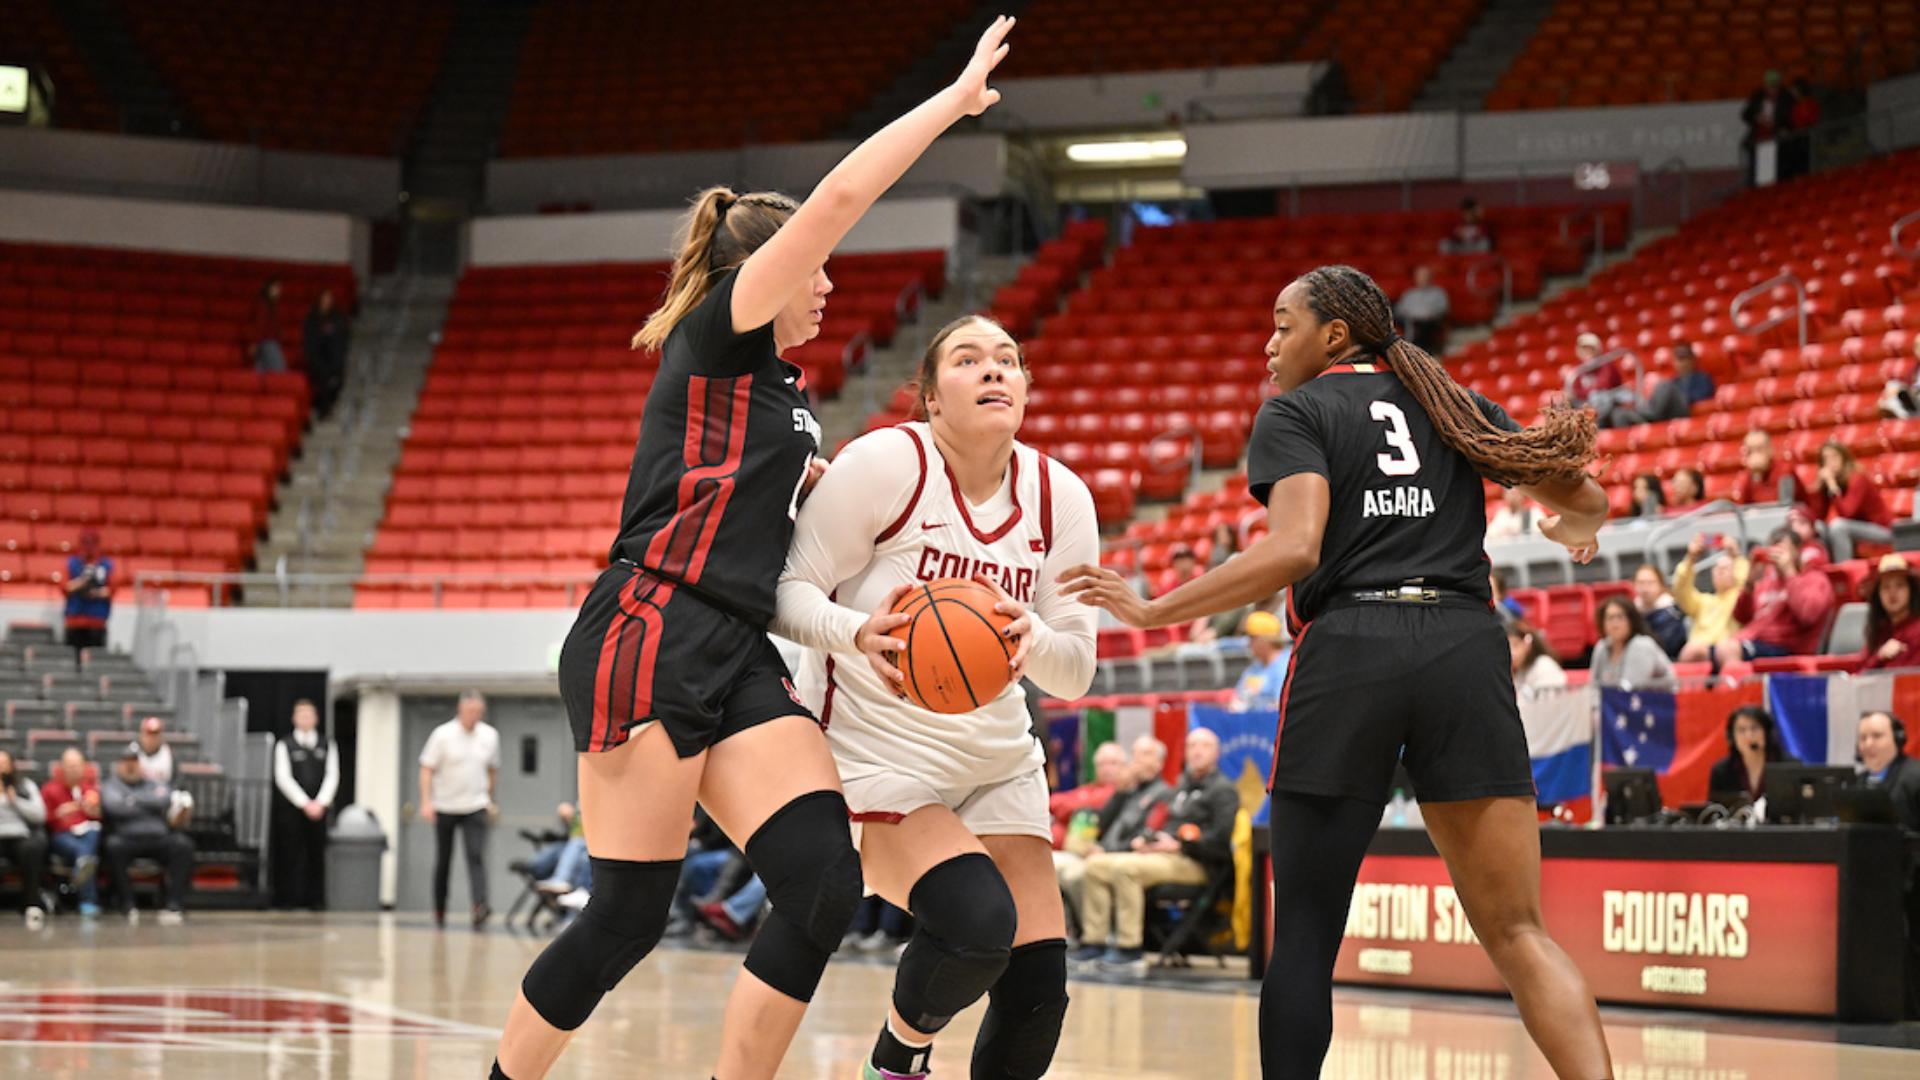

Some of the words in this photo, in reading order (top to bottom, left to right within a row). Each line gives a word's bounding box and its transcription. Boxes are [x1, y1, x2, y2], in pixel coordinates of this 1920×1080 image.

[1369, 401, 1420, 475] 3
[1363, 486, 1435, 518] AGARA
[1603, 890, 1748, 958] COUGARS
